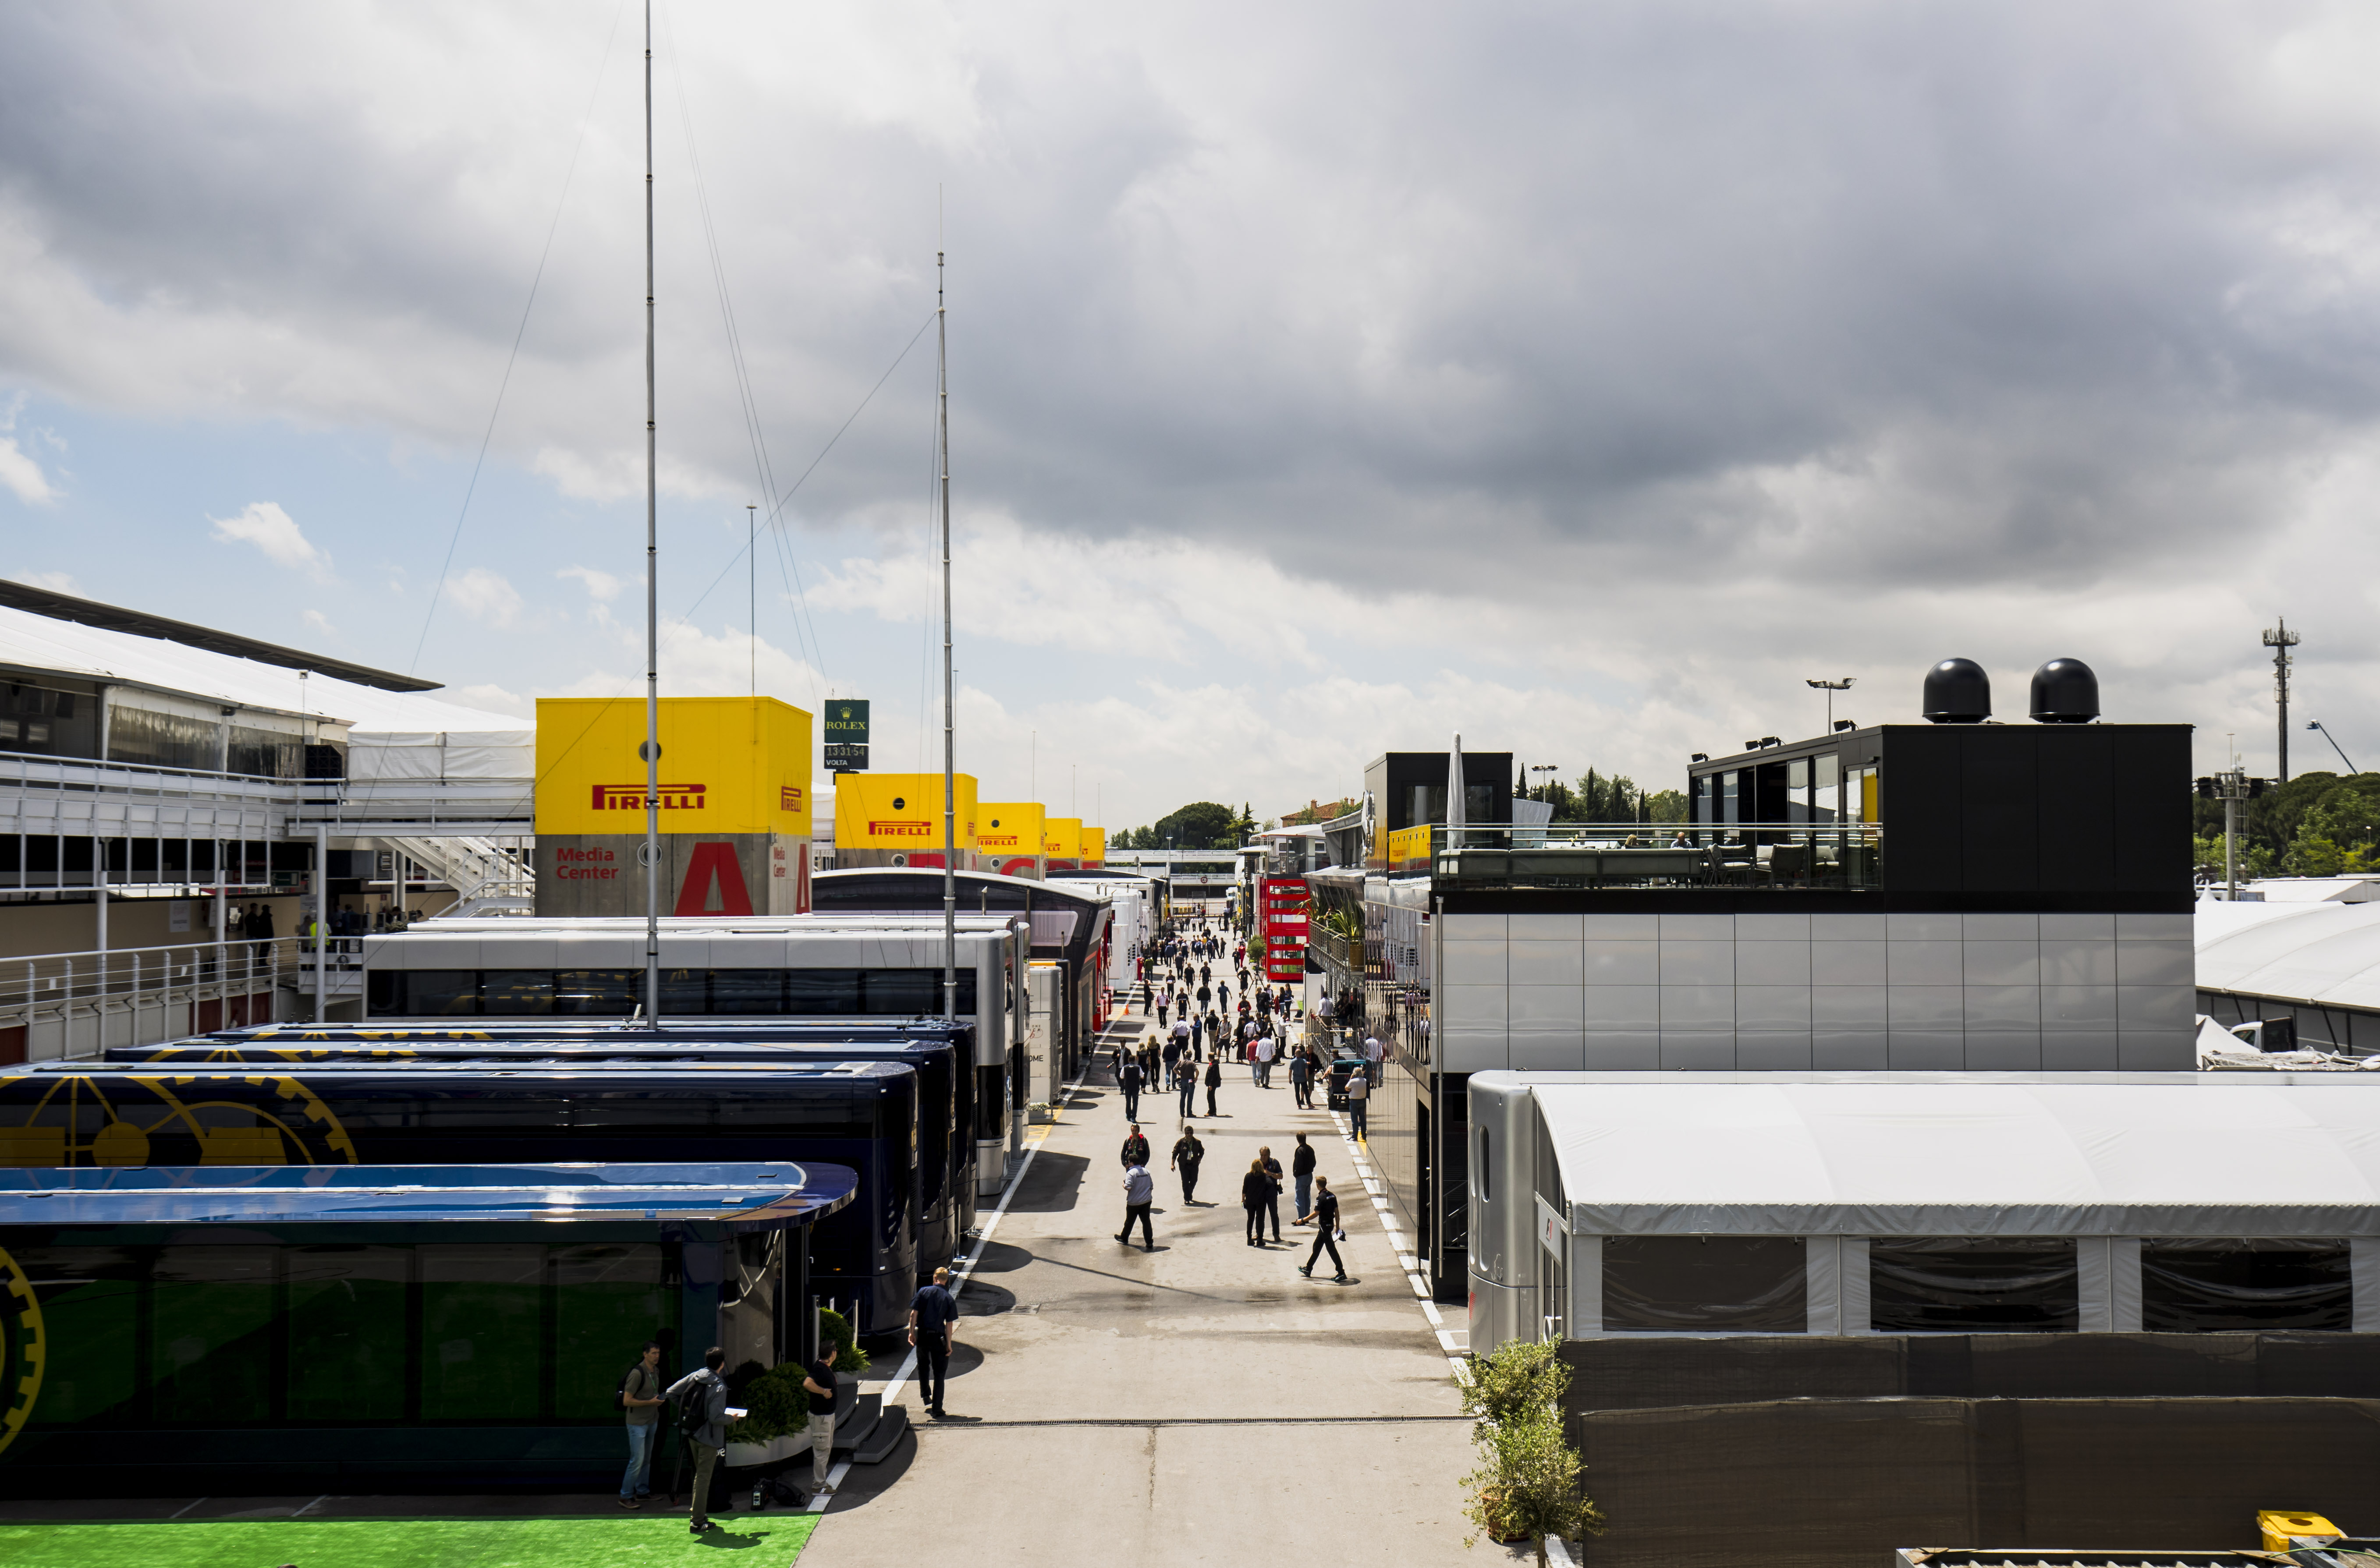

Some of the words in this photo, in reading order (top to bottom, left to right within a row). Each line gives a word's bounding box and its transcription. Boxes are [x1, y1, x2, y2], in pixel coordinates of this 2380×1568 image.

[826, 721, 866, 729] ROLEX
[827, 747, 865, 756] 13:31:54
[869, 821, 932, 835] PIRELLI
[557, 847, 614, 861] Media
[557, 865, 619, 879] Center
